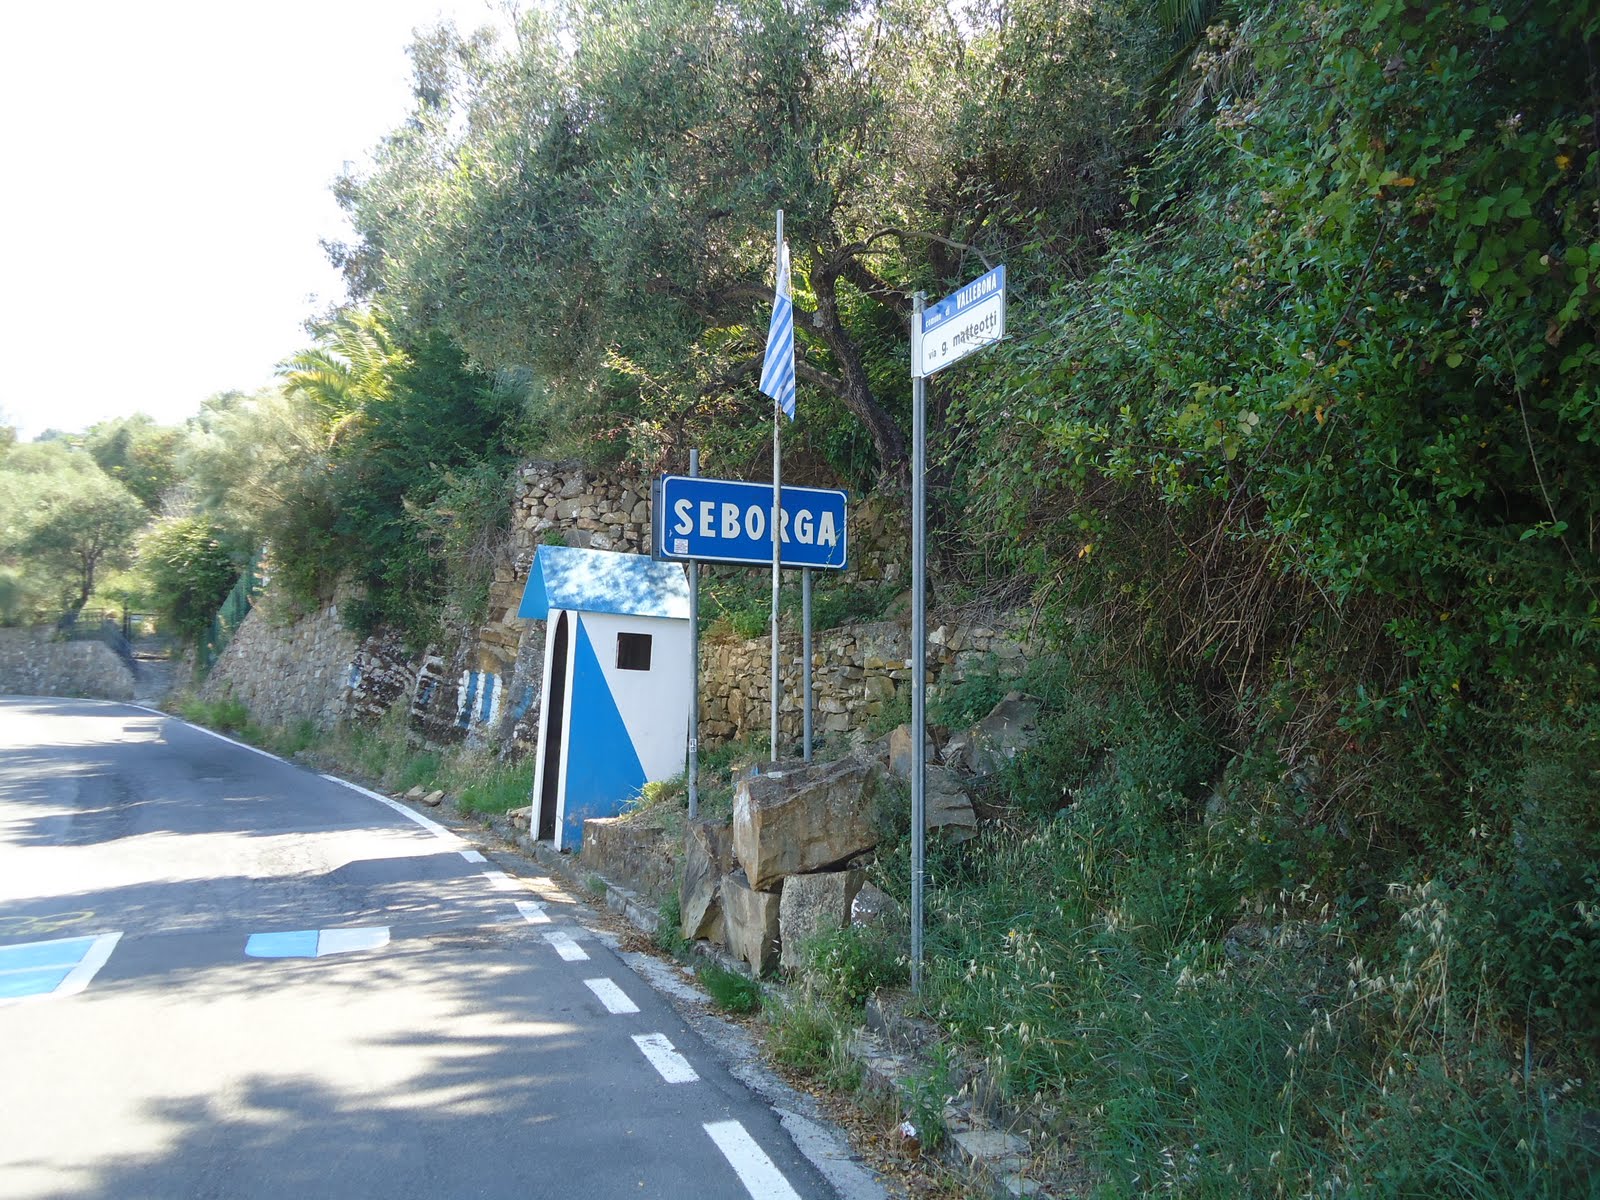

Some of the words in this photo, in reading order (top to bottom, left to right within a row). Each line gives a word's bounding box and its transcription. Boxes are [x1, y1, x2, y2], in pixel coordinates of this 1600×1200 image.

[956, 272, 997, 310] VALLEBONA
[928, 348, 937, 360] via
[952, 310, 997, 347] matteotti
[673, 498, 837, 547] SEBORGA
